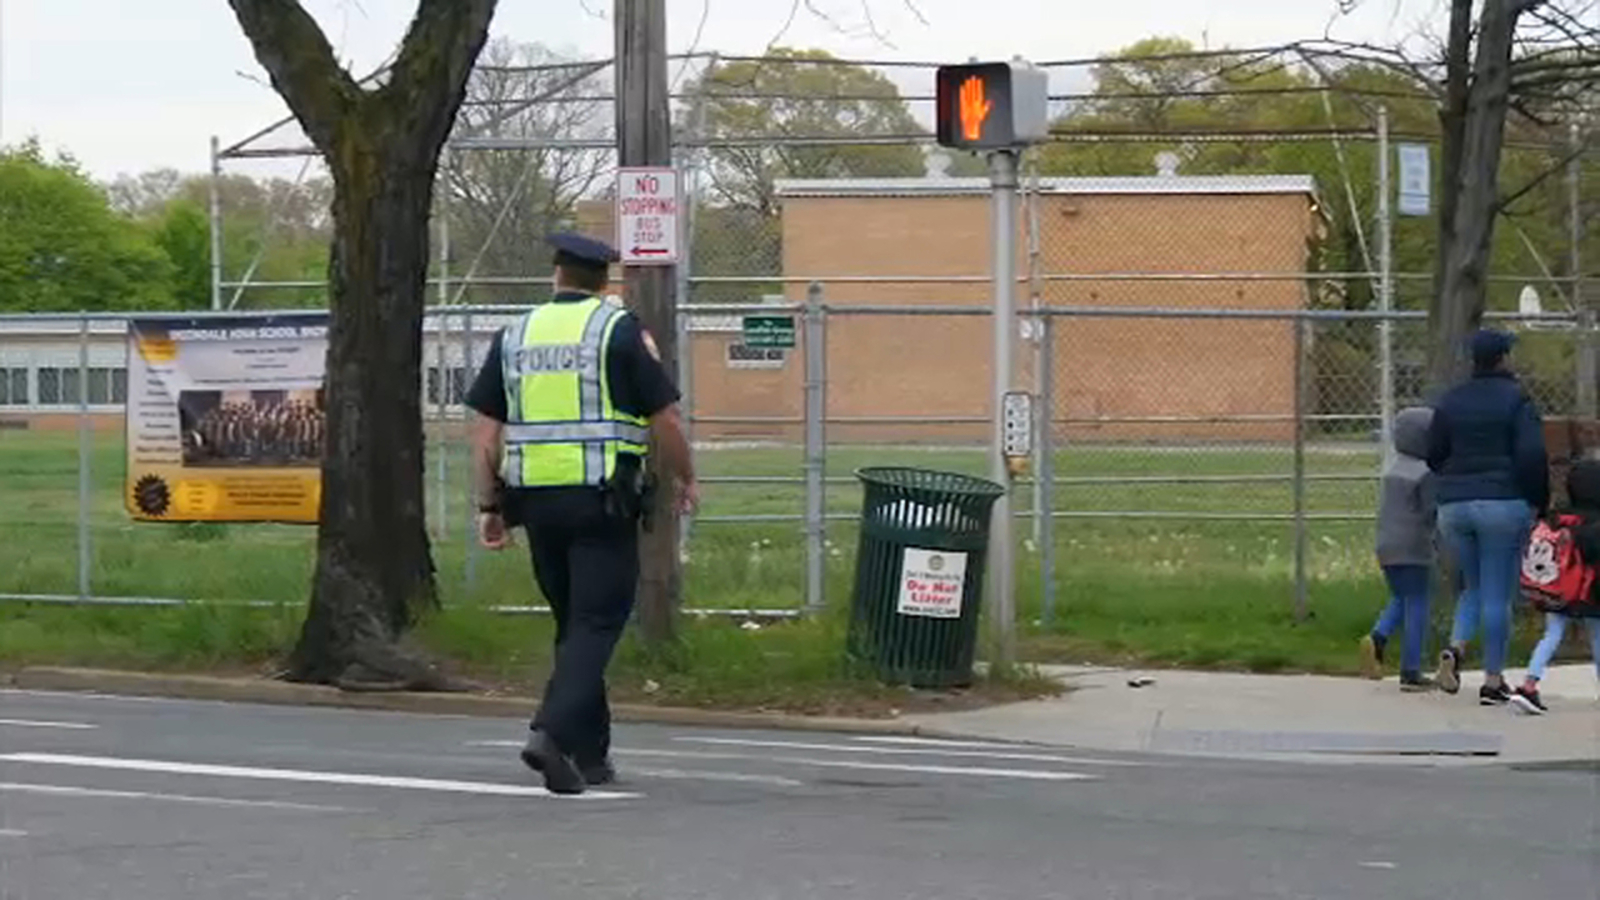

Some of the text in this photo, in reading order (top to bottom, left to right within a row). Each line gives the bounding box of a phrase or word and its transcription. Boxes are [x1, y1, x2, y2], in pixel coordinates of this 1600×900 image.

[635, 177, 659, 194] NO
[621, 198, 676, 215] STOPPING
[637, 217, 661, 230] BUS
[633, 231, 663, 243] STOP
[259, 327, 299, 339] SCHOOL
[514, 346, 589, 373] POLICE
